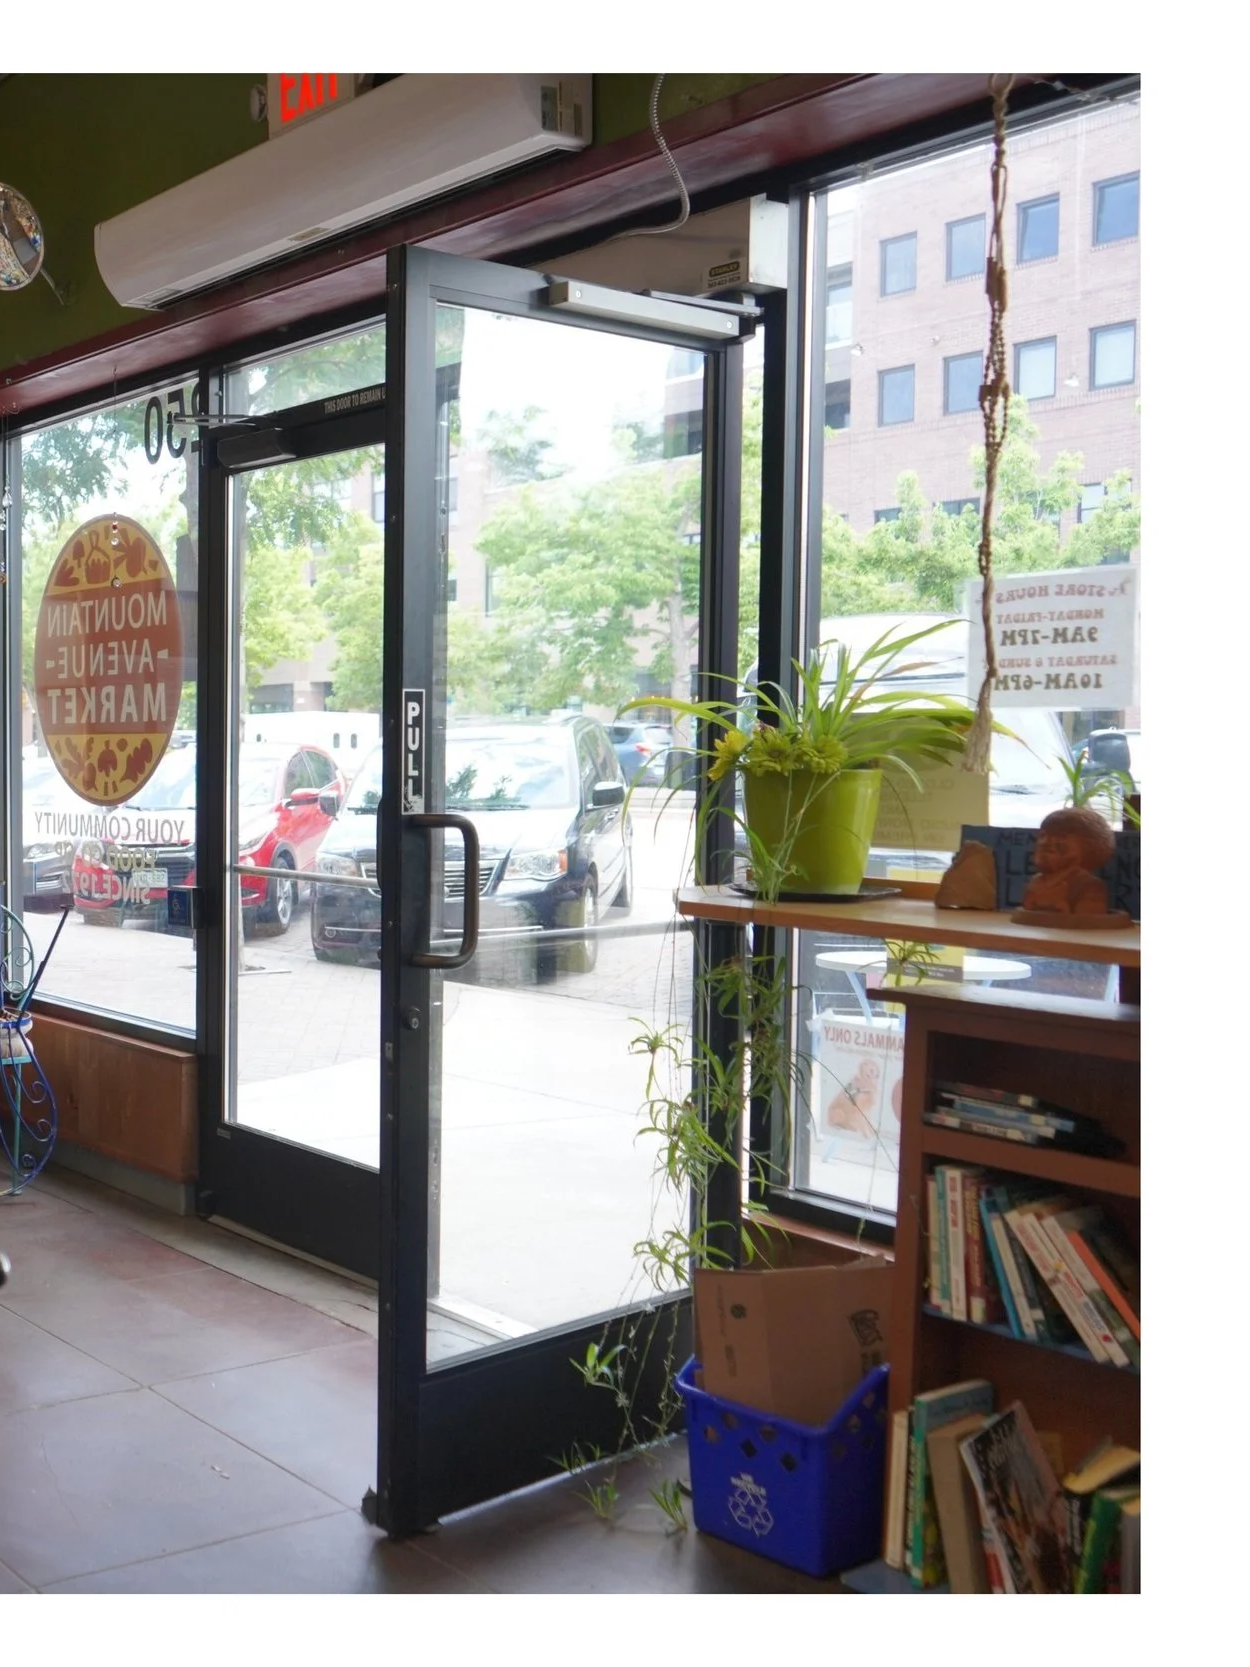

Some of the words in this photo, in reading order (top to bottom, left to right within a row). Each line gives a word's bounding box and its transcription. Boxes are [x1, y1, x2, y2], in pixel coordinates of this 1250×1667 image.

[324, 400, 336, 415] THIS
[337, 396, 351, 411] DOOR
[352, 393, 359, 407] TO
[360, 387, 382, 405] REMAIN
[407, 701, 421, 802] PULL
